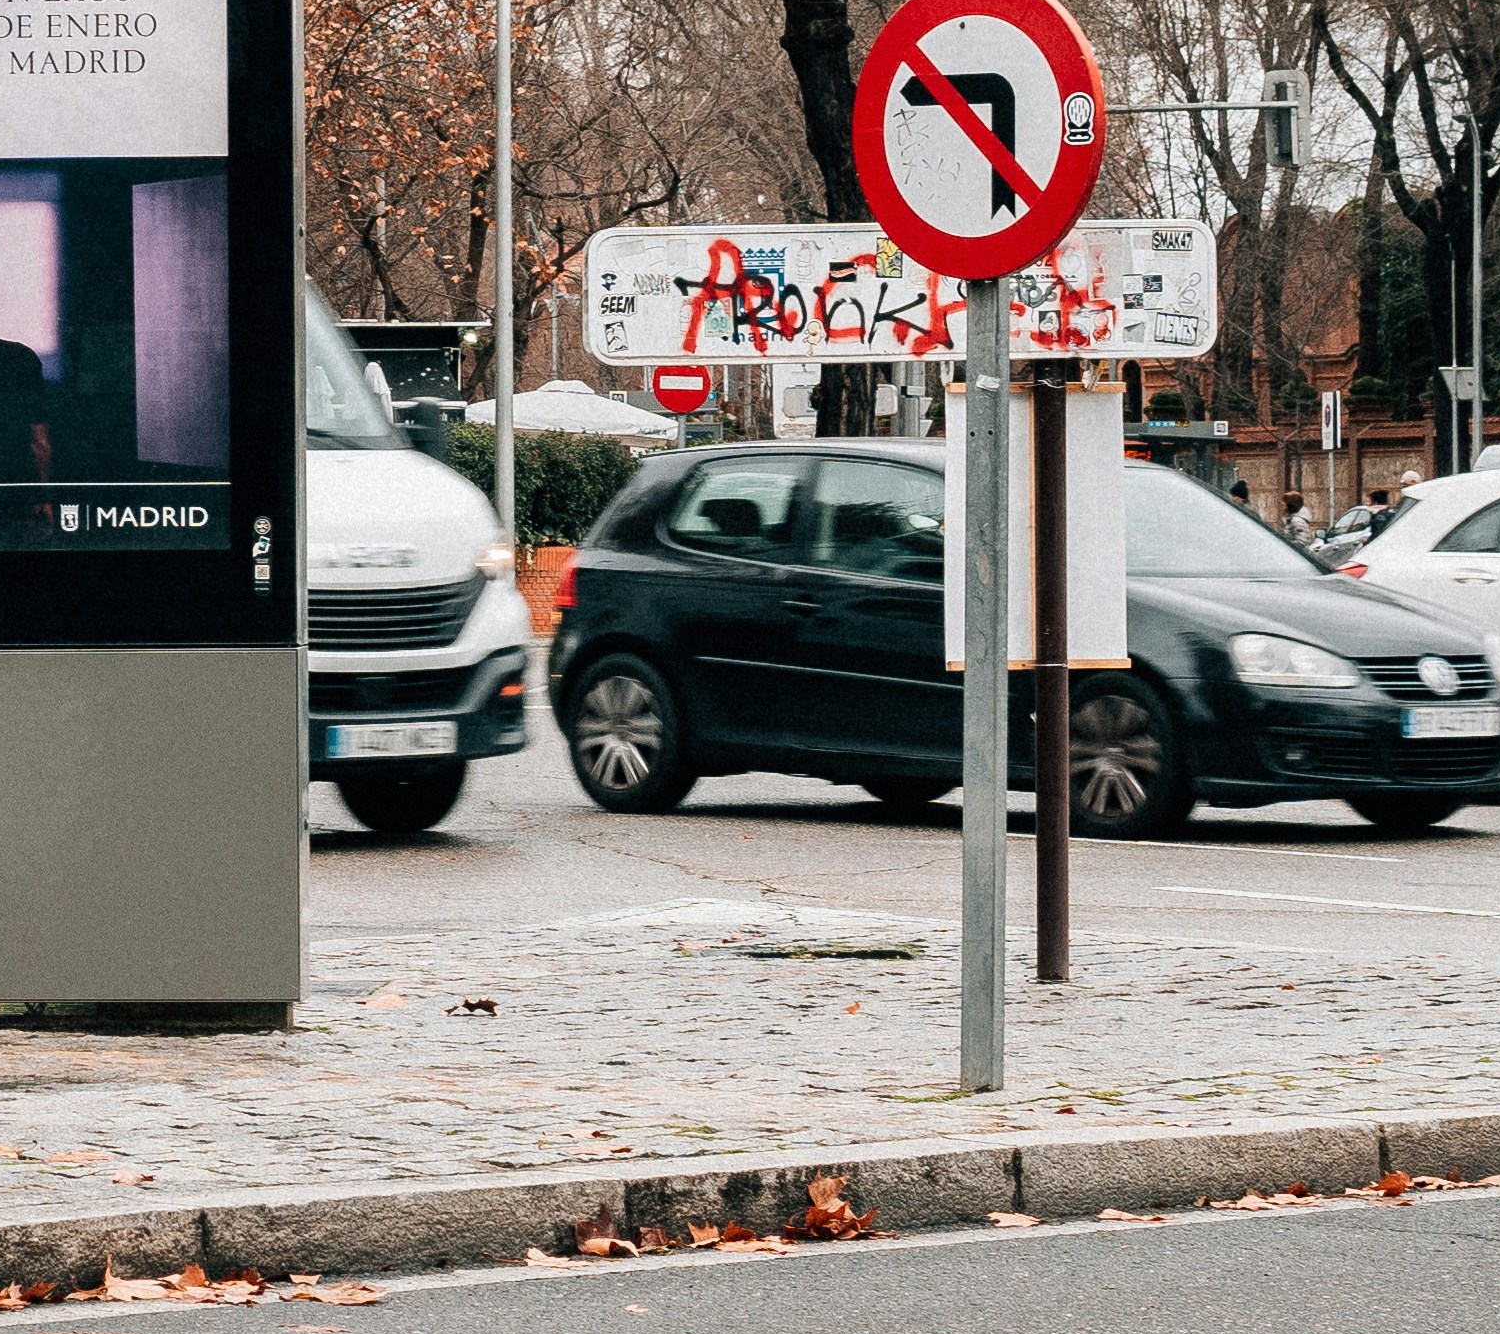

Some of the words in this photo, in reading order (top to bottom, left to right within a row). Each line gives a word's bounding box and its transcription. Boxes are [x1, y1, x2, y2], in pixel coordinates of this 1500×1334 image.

[46, 13, 157, 38] ENERO
[10, 49, 146, 75] MADRID
[600, 294, 636, 315] SEEM
[96, 506, 209, 528] MADRID
